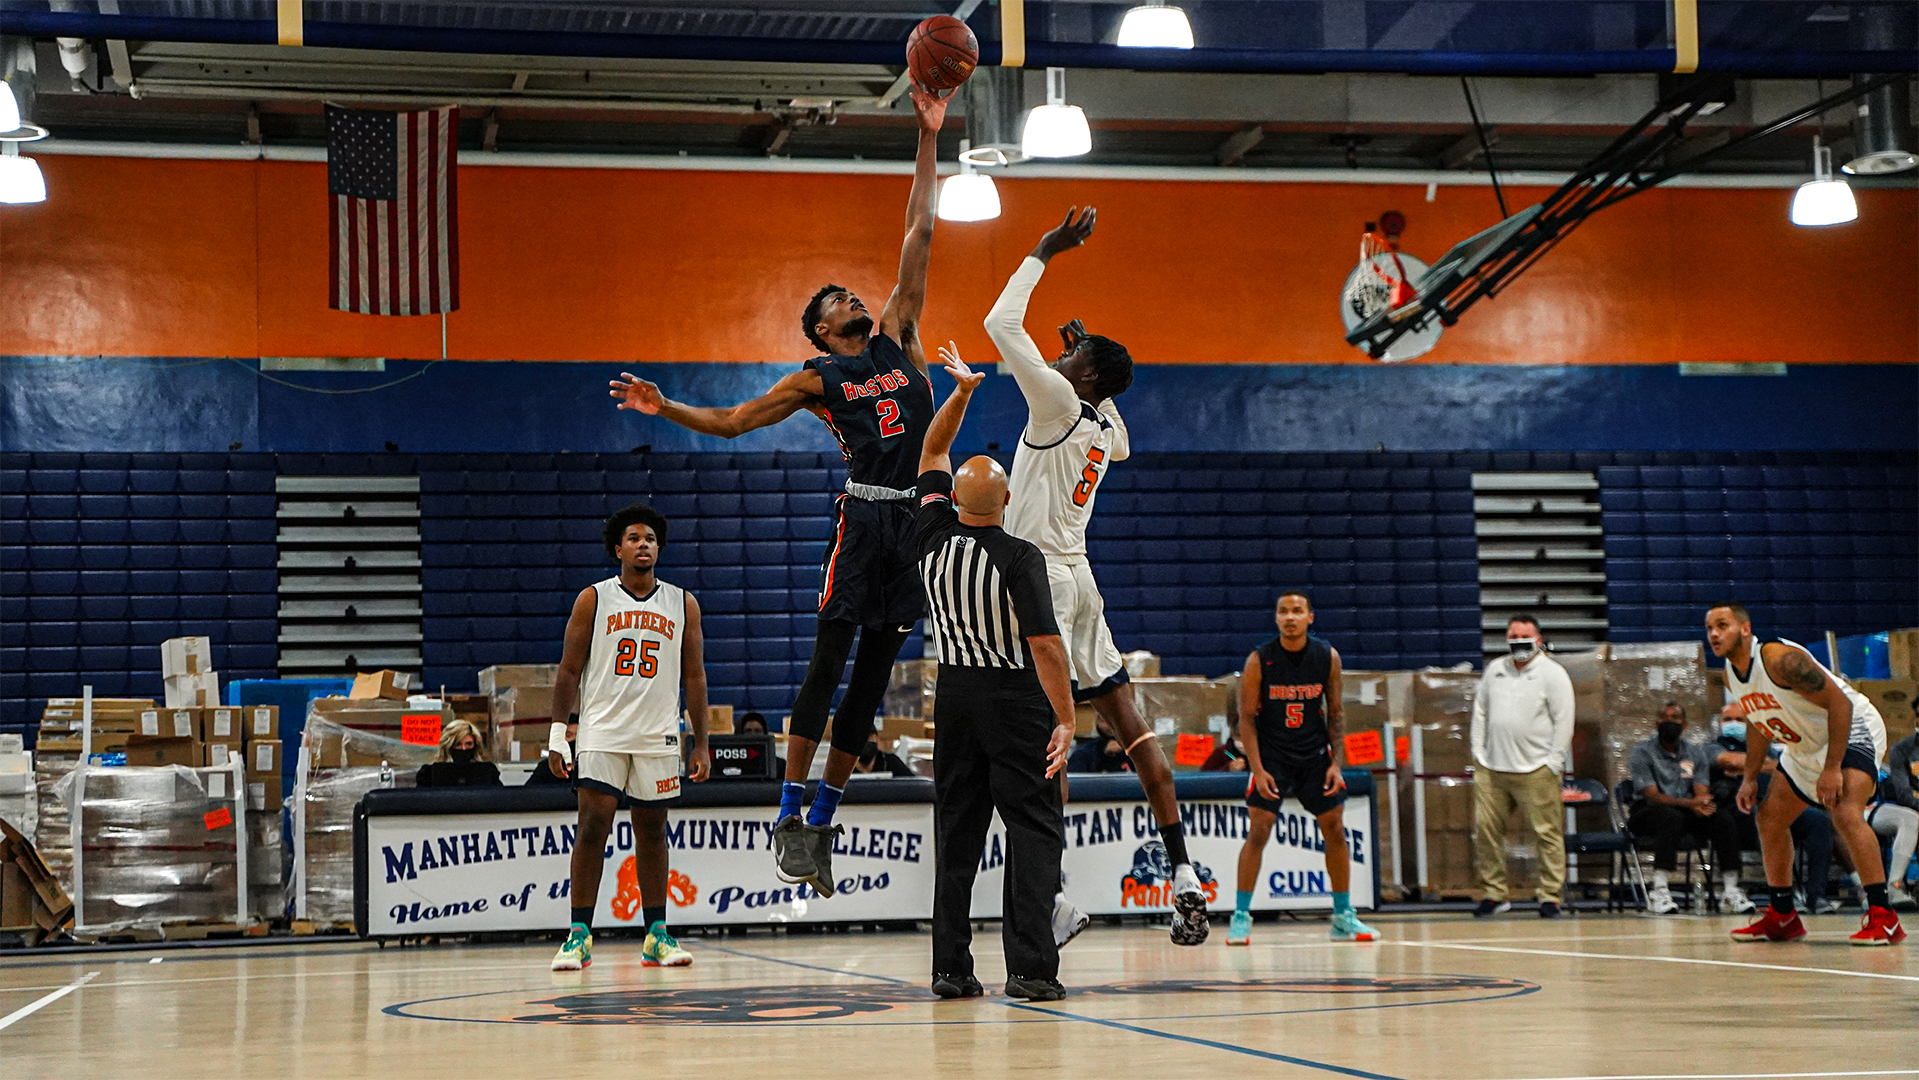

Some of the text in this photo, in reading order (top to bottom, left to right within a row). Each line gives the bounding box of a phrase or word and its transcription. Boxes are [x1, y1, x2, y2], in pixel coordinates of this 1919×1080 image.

[841, 369, 909, 401] HOSTOS
[875, 398, 905, 438] 2
[1073, 445, 1105, 508] 5
[606, 610, 675, 641] PANTHERS
[615, 637, 660, 679] 25
[1269, 683, 1323, 700] HOSTOS
[1285, 702, 1304, 728] 5
[715, 748, 748, 760] POSS
[382, 824, 578, 884] MANHATTAN
[832, 827, 922, 863] LLEGE
[1275, 811, 1365, 865] COLLE
[1269, 870, 1326, 894] CUN
[389, 897, 489, 925] Home
[499, 882, 537, 912] of
